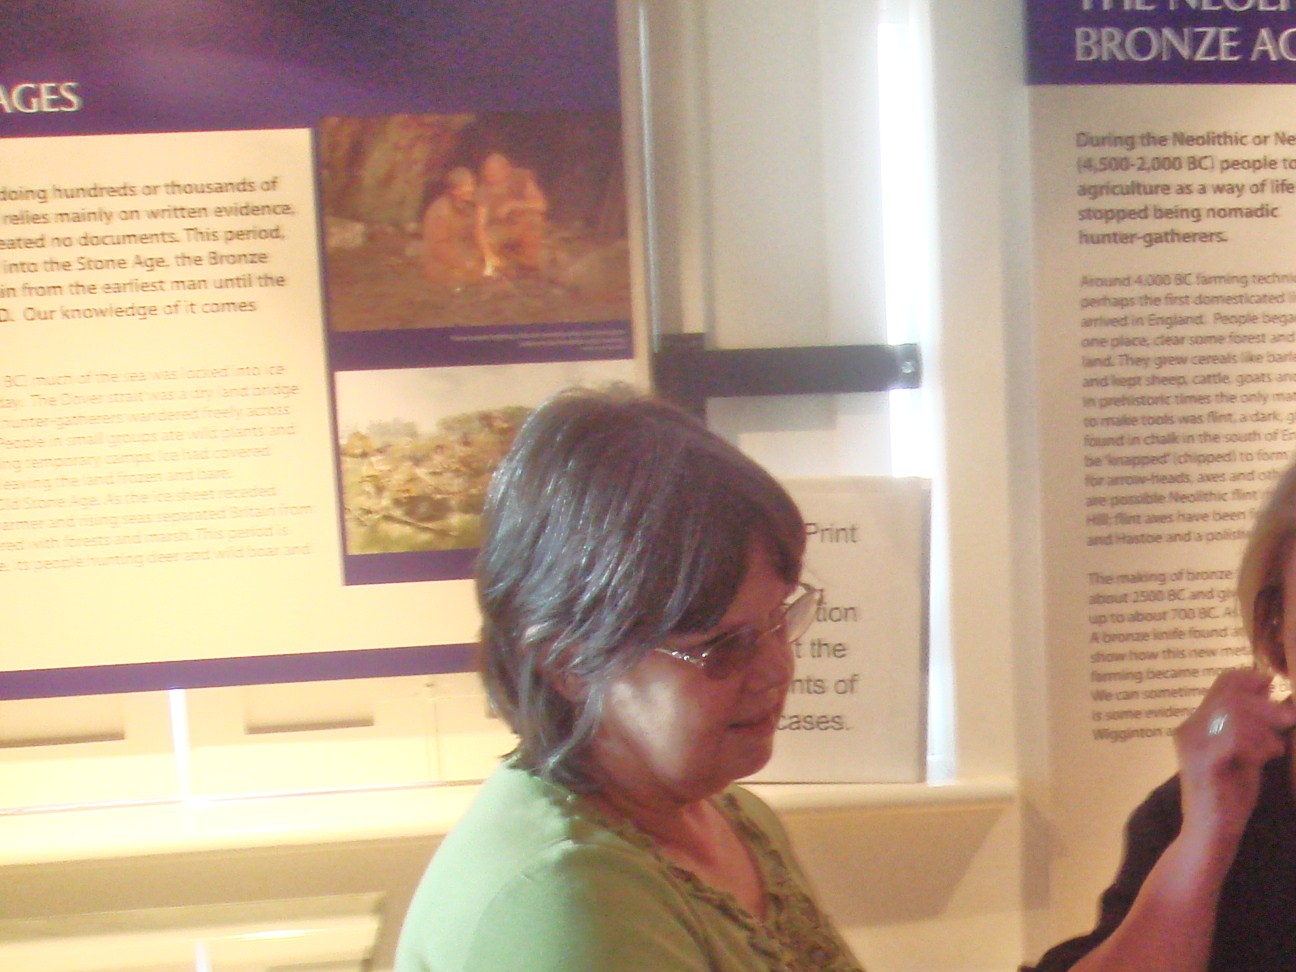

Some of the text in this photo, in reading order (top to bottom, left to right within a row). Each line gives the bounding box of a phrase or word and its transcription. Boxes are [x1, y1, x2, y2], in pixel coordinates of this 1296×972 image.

[1074, 26, 1241, 62] BRONZE
[1076, 132, 1135, 151] During
[1139, 131, 1168, 146] the
[1171, 131, 1247, 146] Neolithic
[1252, 135, 1271, 146] or
[1220, 155, 1278, 174] people
[52, 182, 137, 198] hundreds
[141, 185, 160, 196] or
[164, 178, 256, 194] thousands
[260, 176, 278, 192] of
[1077, 180, 1171, 199] agriculture
[1175, 184, 1194, 195] as
[1198, 184, 1208, 195] a
[1212, 184, 1243, 199] way
[1250, 180, 1267, 195] of
[1271, 180, 1295, 195] life
[2, 209, 49, 225] relies
[54, 207, 113, 227] mainly
[118, 210, 140, 221] on
[146, 204, 208, 219] written
[1078, 204, 1279, 224] stopped being nomadic
[52, 237, 72, 247] no
[184, 227, 219, 242] This
[1079, 228, 1228, 248] hunter-gatherers.
[3, 258, 39, 273] into
[44, 257, 71, 272] the
[77, 255, 127, 270] Stone
[174, 251, 203, 266] the
[208, 249, 268, 264] Bronze
[22, 281, 62, 297] from
[69, 280, 97, 295] the
[103, 277, 164, 293] earliest
[170, 280, 208, 290] man
[213, 273, 252, 289] until
[258, 272, 286, 287] the
[23, 306, 56, 321] Our
[60, 302, 158, 322] knowledge
[163, 300, 180, 315] of
[184, 299, 196, 314] it
[201, 301, 257, 312] comes
[811, 638, 847, 659] the
[834, 674, 860, 695] of
